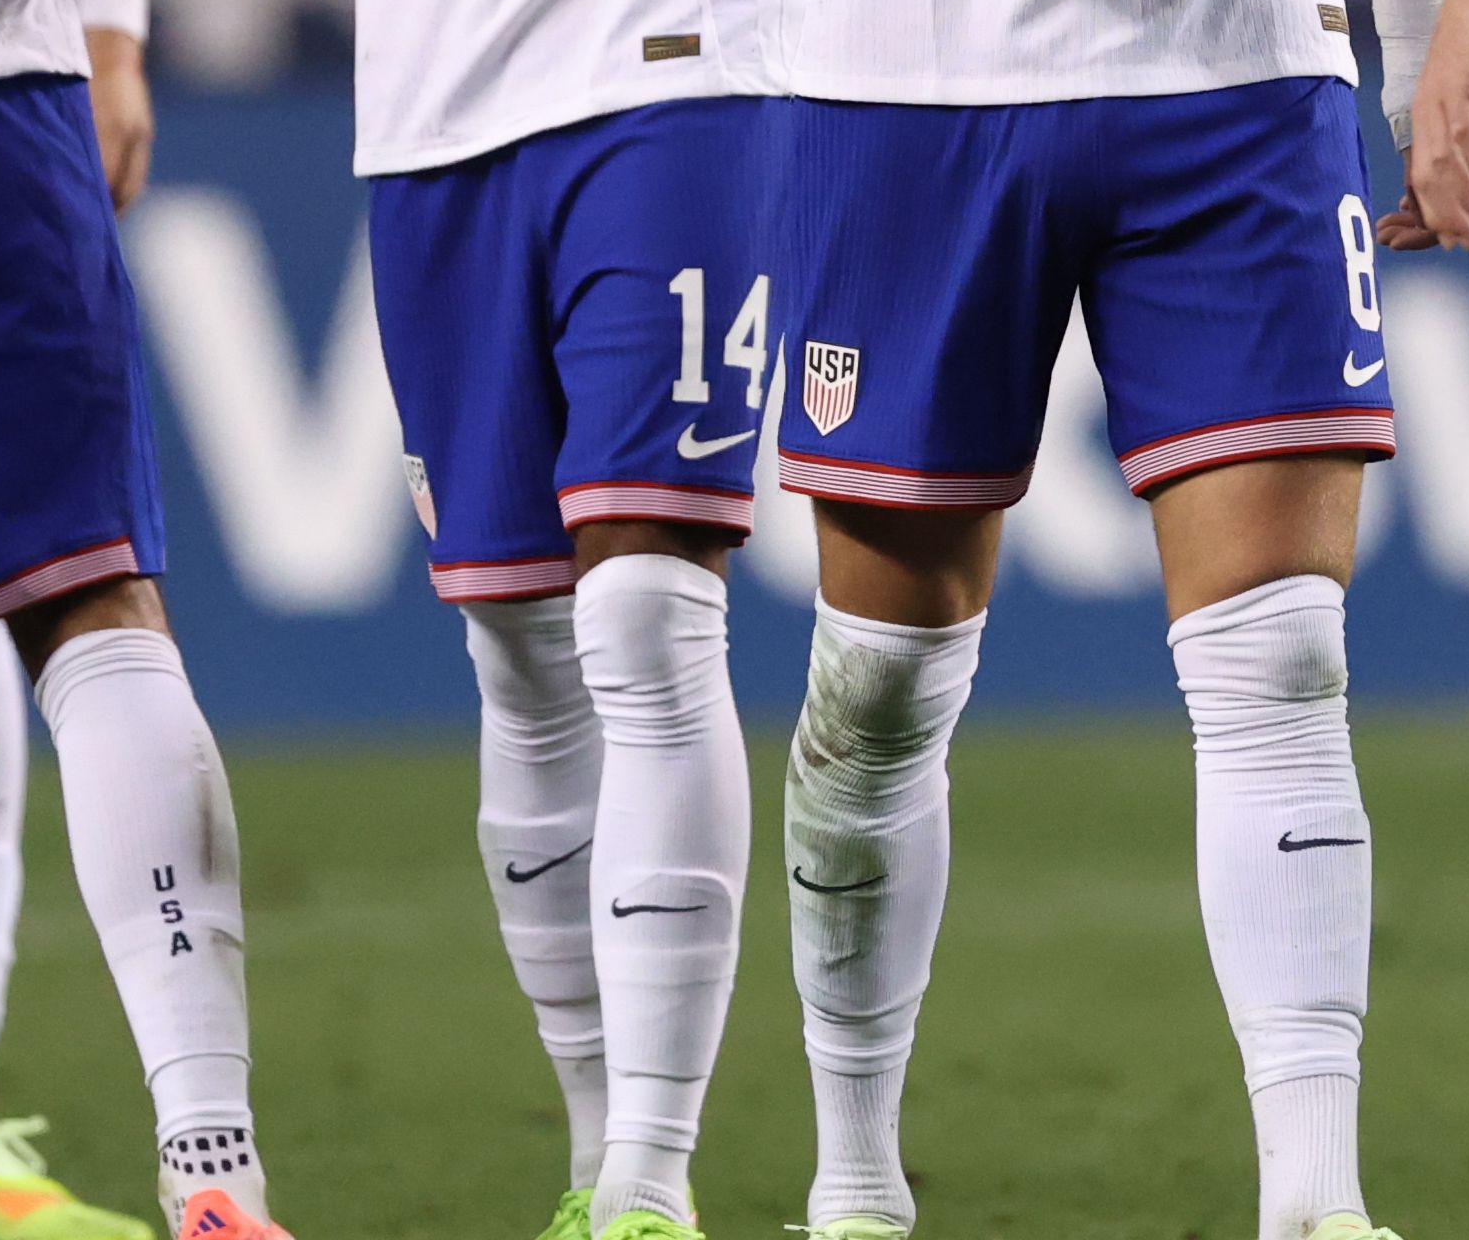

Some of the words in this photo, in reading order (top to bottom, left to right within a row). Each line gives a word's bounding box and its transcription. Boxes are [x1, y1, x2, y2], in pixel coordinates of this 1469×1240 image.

[1337, 193, 1381, 333] 8
[668, 267, 770, 409] 14
[809, 346, 856, 384] USA
[152, 864, 193, 957] USA
